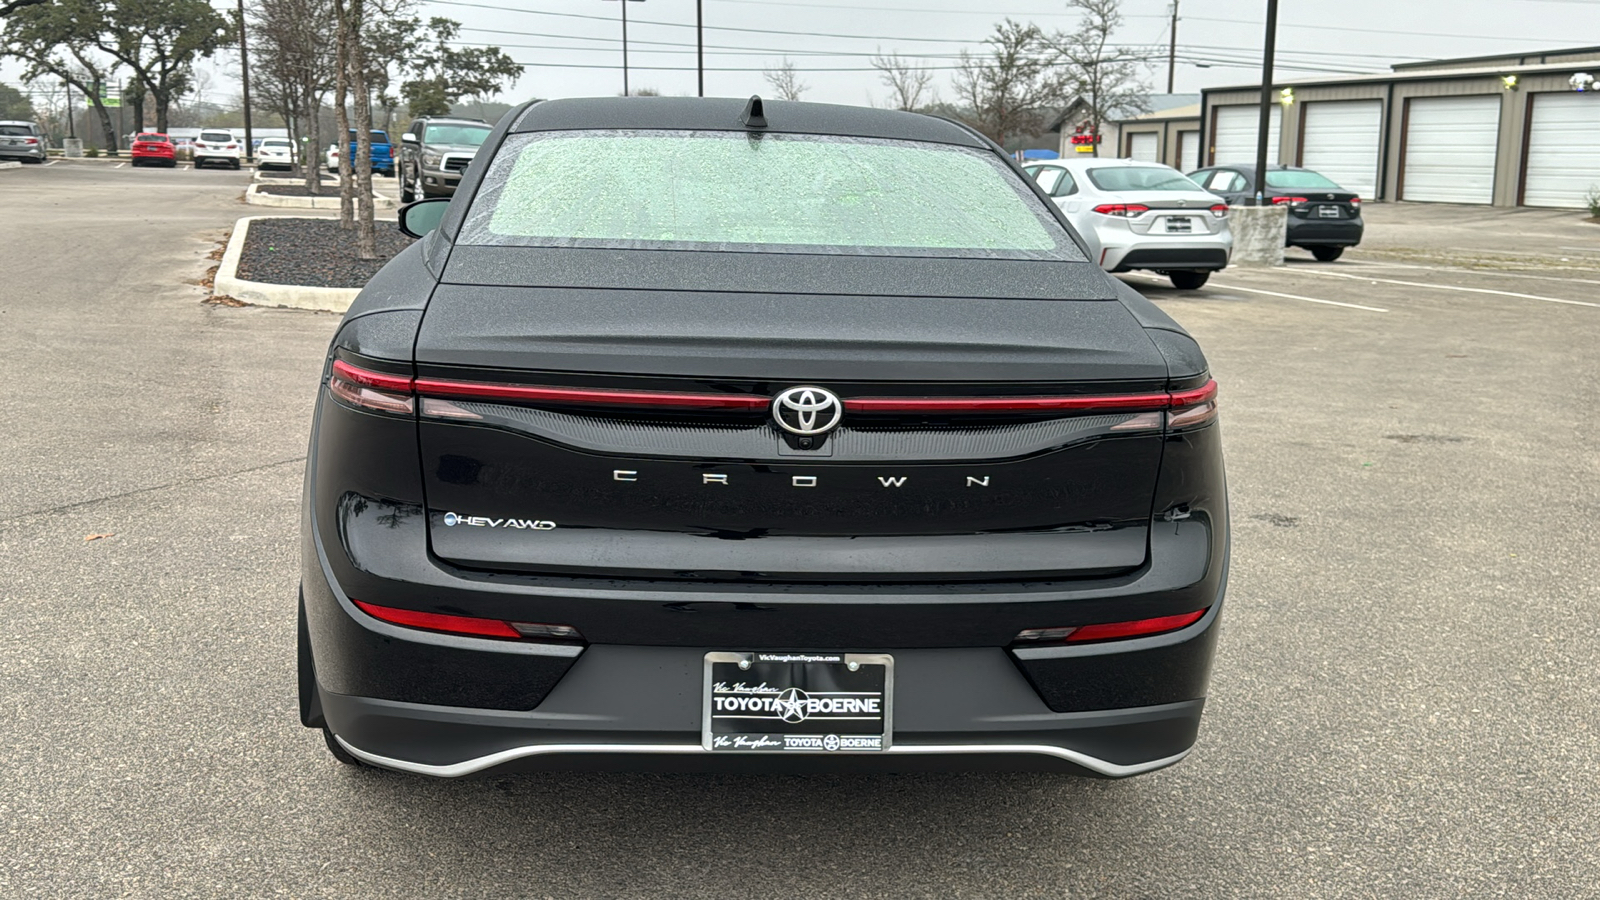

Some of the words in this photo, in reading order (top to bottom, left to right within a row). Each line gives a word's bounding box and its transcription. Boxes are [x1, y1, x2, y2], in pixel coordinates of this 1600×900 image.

[613, 470, 989, 487] CROWN
[758, 654, 841, 663] VicVaughanToyota.com
[713, 696, 784, 712] TOYOTA
[806, 698, 881, 713] BOERNE
[733, 735, 782, 749] Vaughan
[784, 738, 823, 747] TOYOTA
[840, 738, 882, 747] BOERNE
